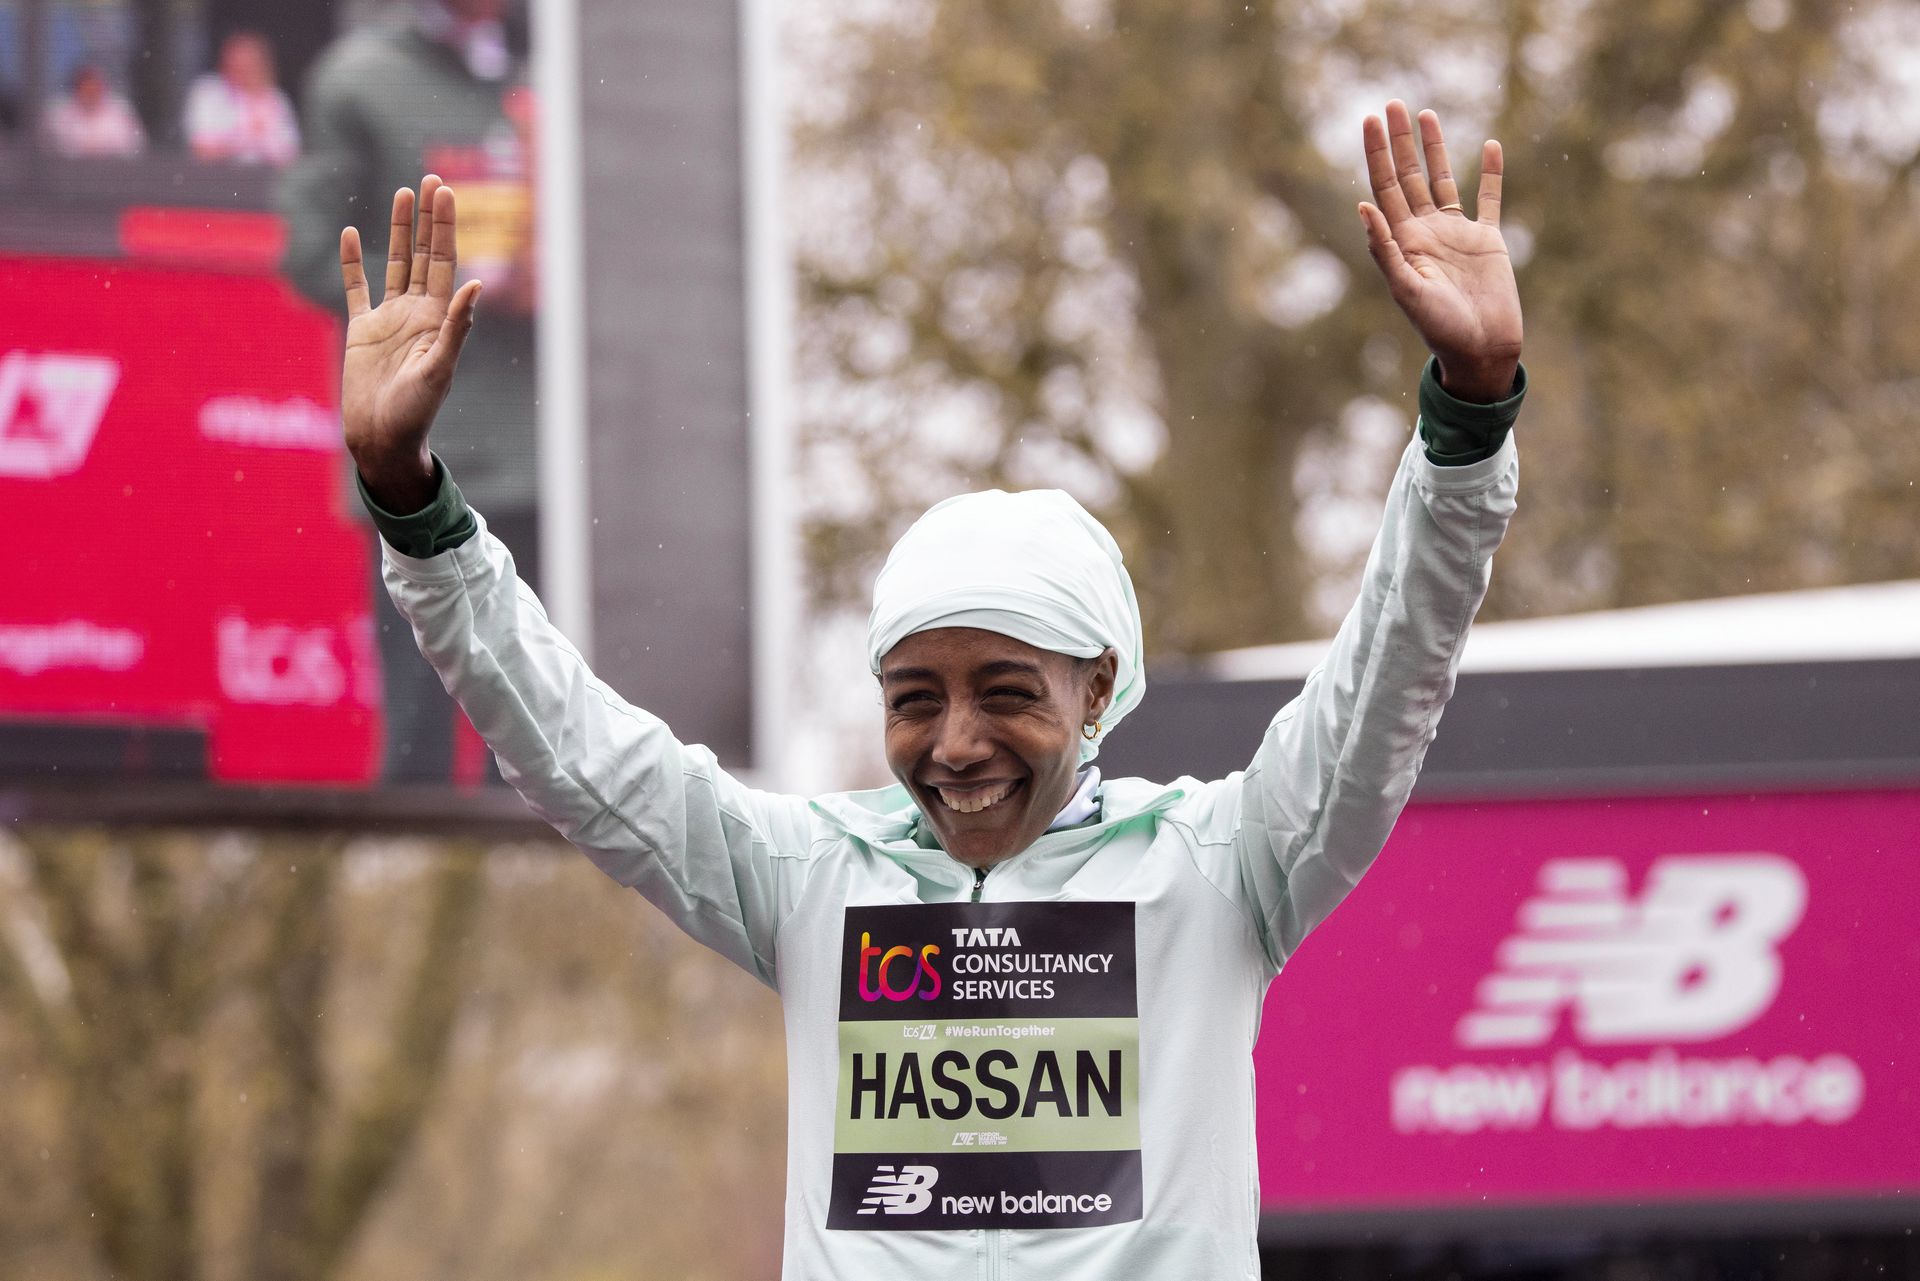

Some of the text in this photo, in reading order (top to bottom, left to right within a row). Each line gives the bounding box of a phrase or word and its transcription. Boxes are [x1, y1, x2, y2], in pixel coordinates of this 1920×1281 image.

[952, 927, 1022, 948] TATA
[858, 931, 942, 1002] tcs
[952, 953, 1114, 974] CONSULTANCY
[952, 979, 1056, 1001] SERVICES
[945, 1025, 1056, 1040] #WeRunTogether
[850, 1049, 1122, 1121] HASSAN
[1391, 1047, 1865, 1134] new balance
[856, 1165, 1113, 1215] NB new balance
